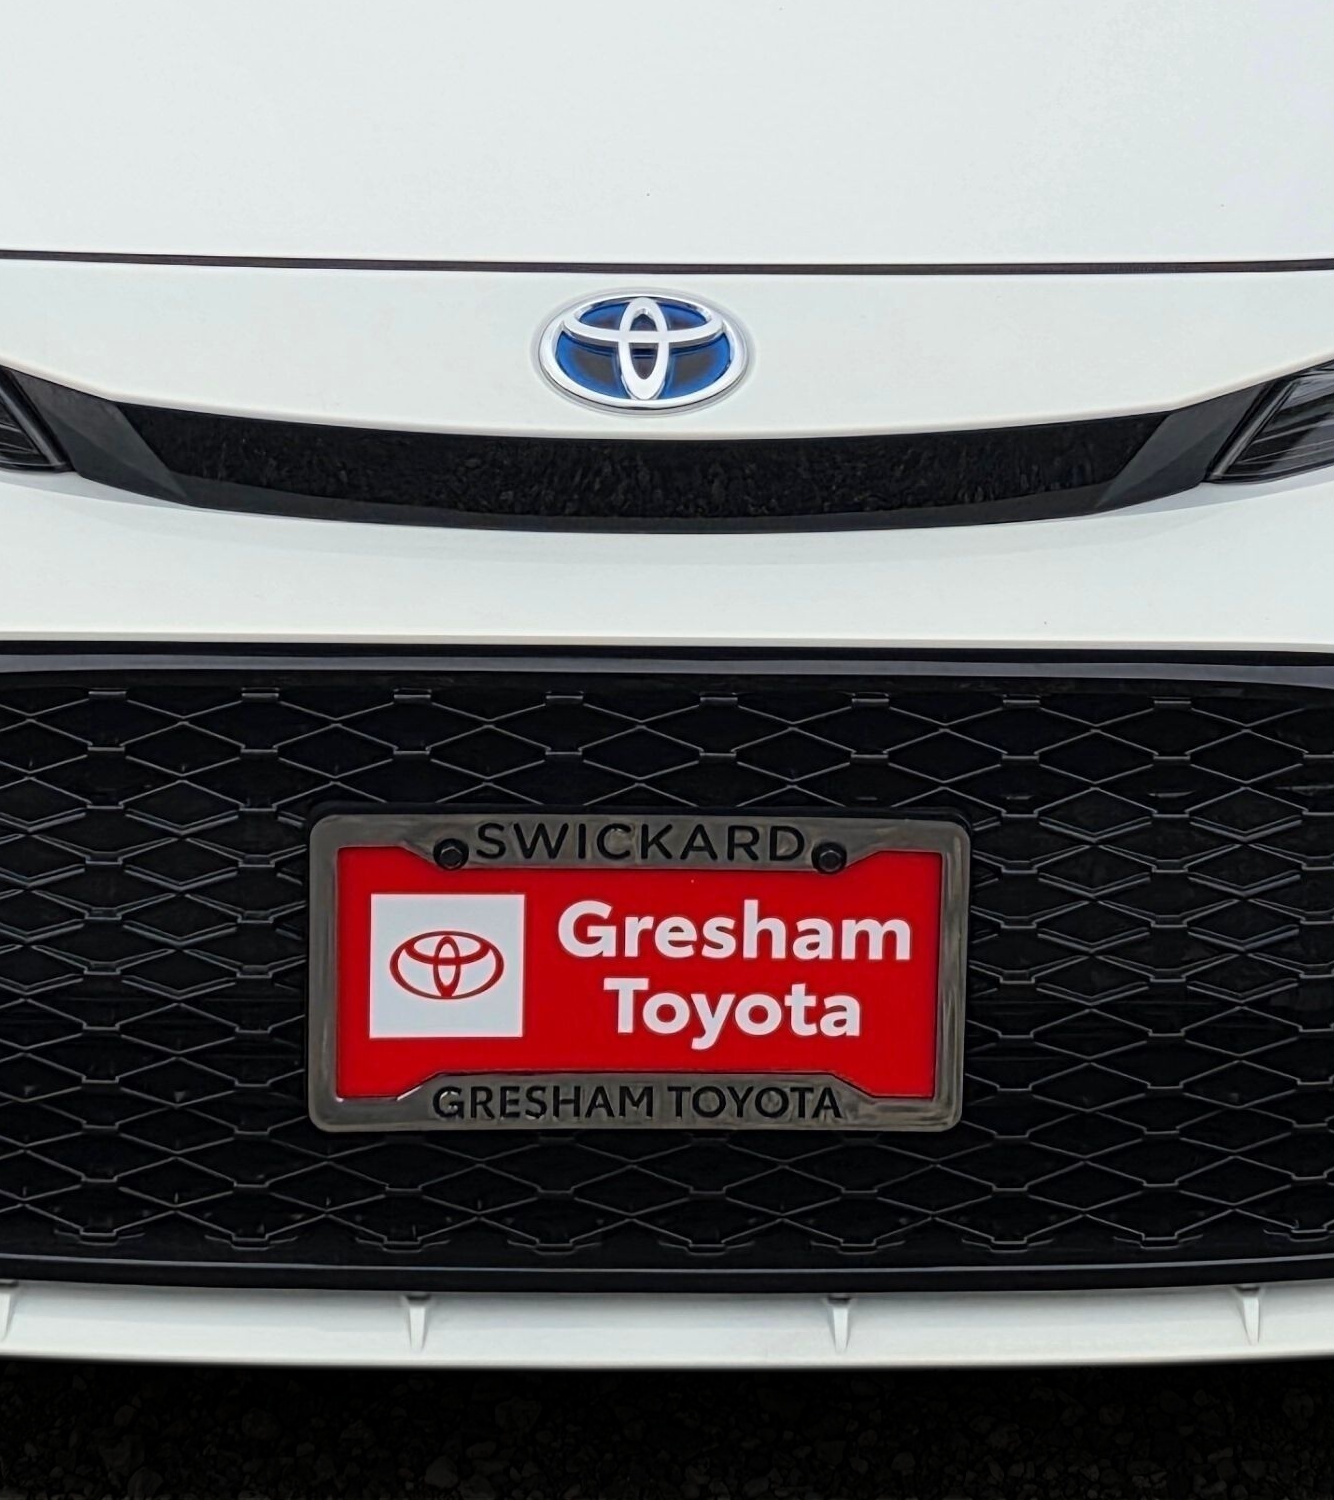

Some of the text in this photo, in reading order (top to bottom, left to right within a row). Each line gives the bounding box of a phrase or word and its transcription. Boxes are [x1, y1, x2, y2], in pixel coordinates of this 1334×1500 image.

[476, 823, 806, 861] SWICKARD
[558, 899, 911, 960] Gresham
[603, 977, 861, 1050] Toyota
[433, 1085, 843, 1120] GRESHAM TOYOTA
